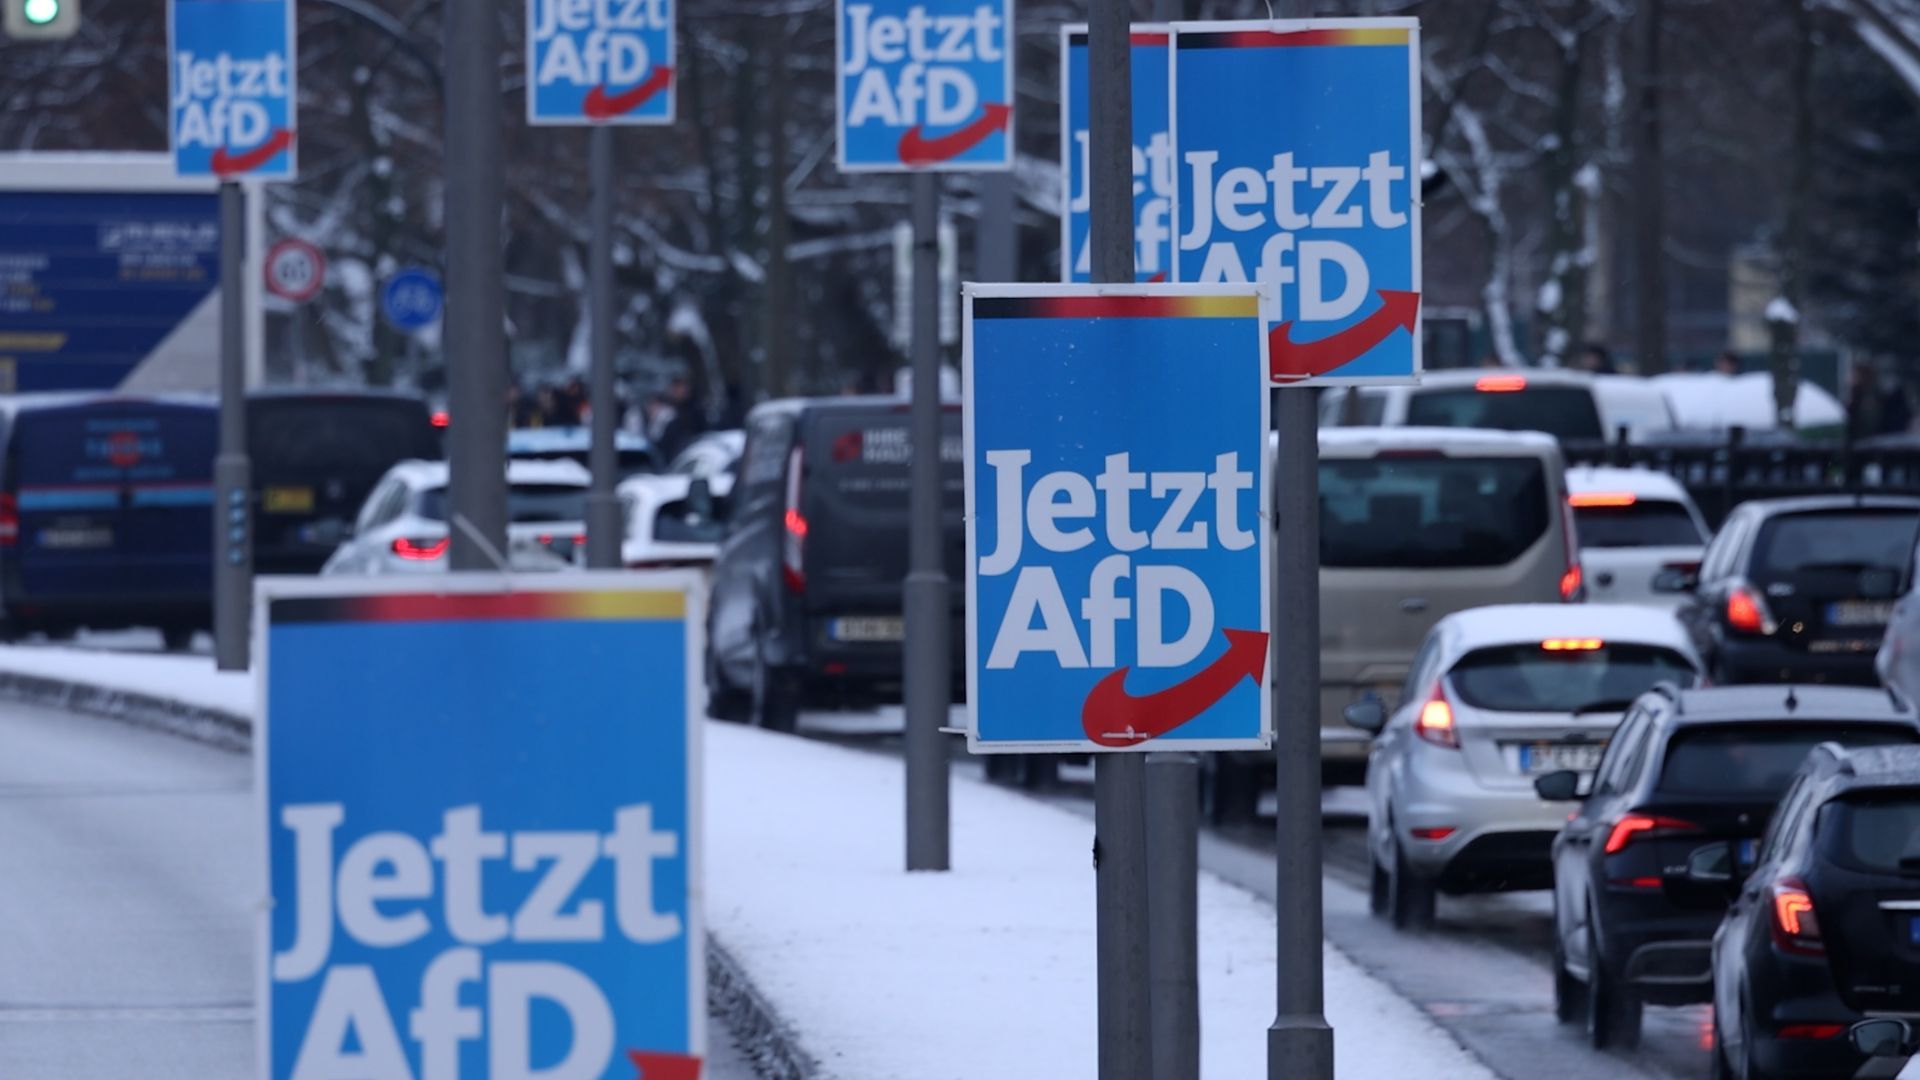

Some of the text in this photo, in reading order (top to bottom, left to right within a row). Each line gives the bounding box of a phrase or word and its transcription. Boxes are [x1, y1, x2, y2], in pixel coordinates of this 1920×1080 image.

[534, 0, 666, 40] Jetzt
[845, 6, 1002, 76] Jetzt
[174, 51, 285, 107] Jetzt
[538, 30, 649, 85] AfD
[178, 97, 270, 147] AfD
[847, 62, 978, 126] AfD
[1180, 150, 1408, 250] Jetzt
[978, 449, 1256, 576] Jetzt
[985, 554, 1215, 669] AfD
[273, 803, 682, 982] Jetzt
[289, 947, 616, 1080] AfD
